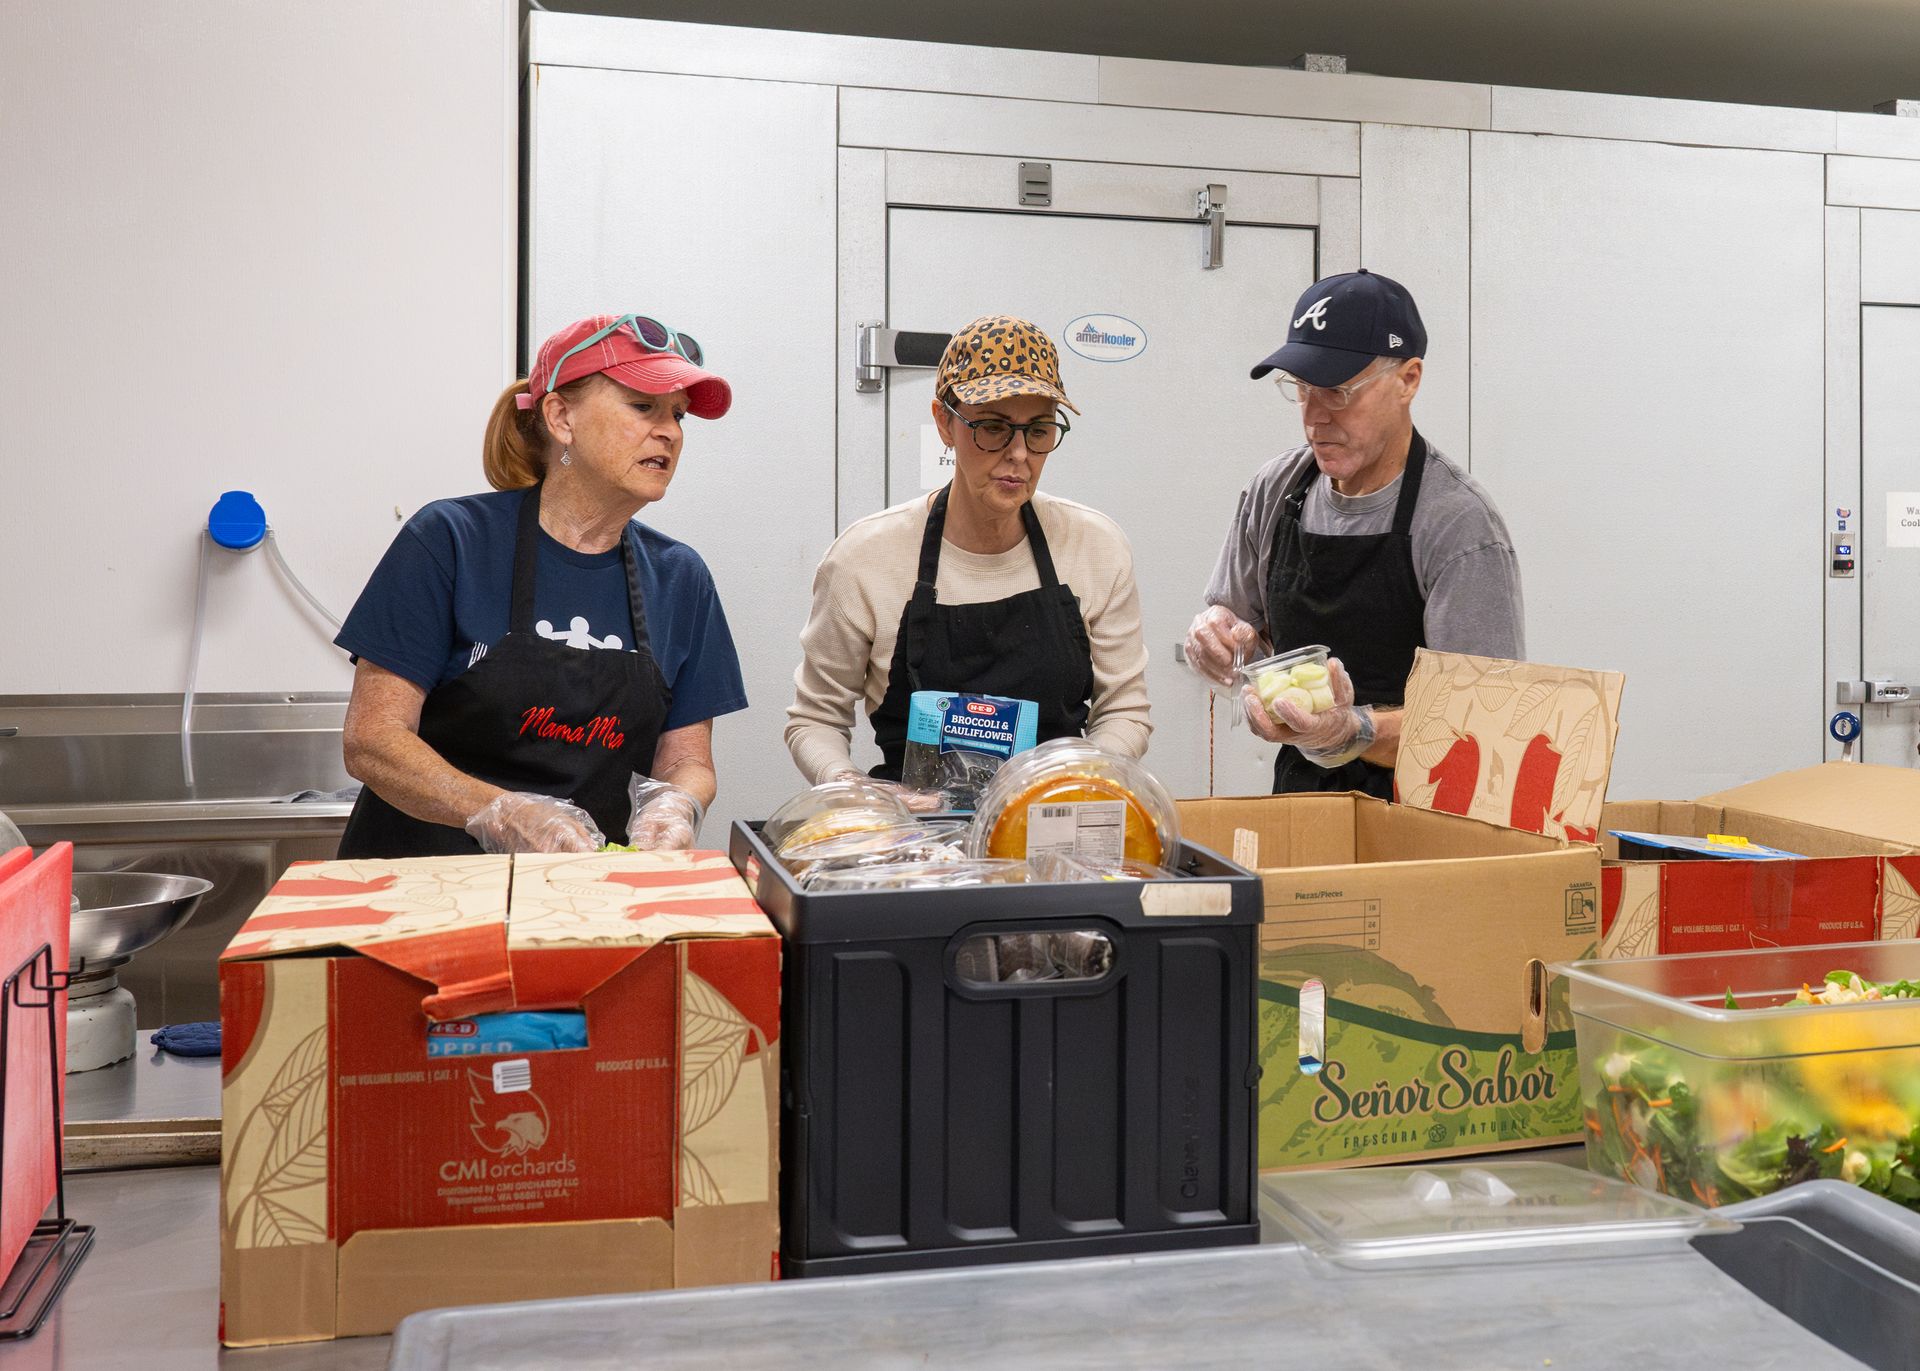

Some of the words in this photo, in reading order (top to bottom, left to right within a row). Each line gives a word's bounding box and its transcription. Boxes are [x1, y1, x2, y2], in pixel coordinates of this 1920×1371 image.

[1294, 296, 1332, 331] A
[1076, 332, 1136, 347] amerikooler
[519, 706, 585, 743] Mama
[586, 715, 625, 749] Mia
[951, 714, 1000, 730] BROCCOLI
[1001, 721, 1009, 731] &
[944, 725, 1013, 742] CAULIFLOWER
[1671, 925, 1683, 934] ONE
[1684, 925, 1705, 934] VOLUME
[1705, 924, 1724, 933] BUSHEL
[1818, 922, 1842, 930] PRODUCE
[1843, 921, 1850, 929] OF
[595, 1059, 633, 1072] PRODUCE
[634, 1058, 646, 1070] OF
[358, 1072, 393, 1086] VOLUME
[393, 1071, 425, 1084] BUSHEL
[1314, 1060, 1434, 1123] Señor
[1437, 1049, 1557, 1110] Sabor
[1343, 1129, 1417, 1149] FRESCURA
[1459, 1118, 1527, 1137] NATURAL
[438, 1158, 487, 1181] CMI
[490, 1153, 577, 1178] orchards
[496, 1182, 514, 1192] CMI
[515, 1179, 562, 1190] ORCHARDS
[564, 1177, 579, 1187] LLC
[497, 1192, 512, 1202] WA
